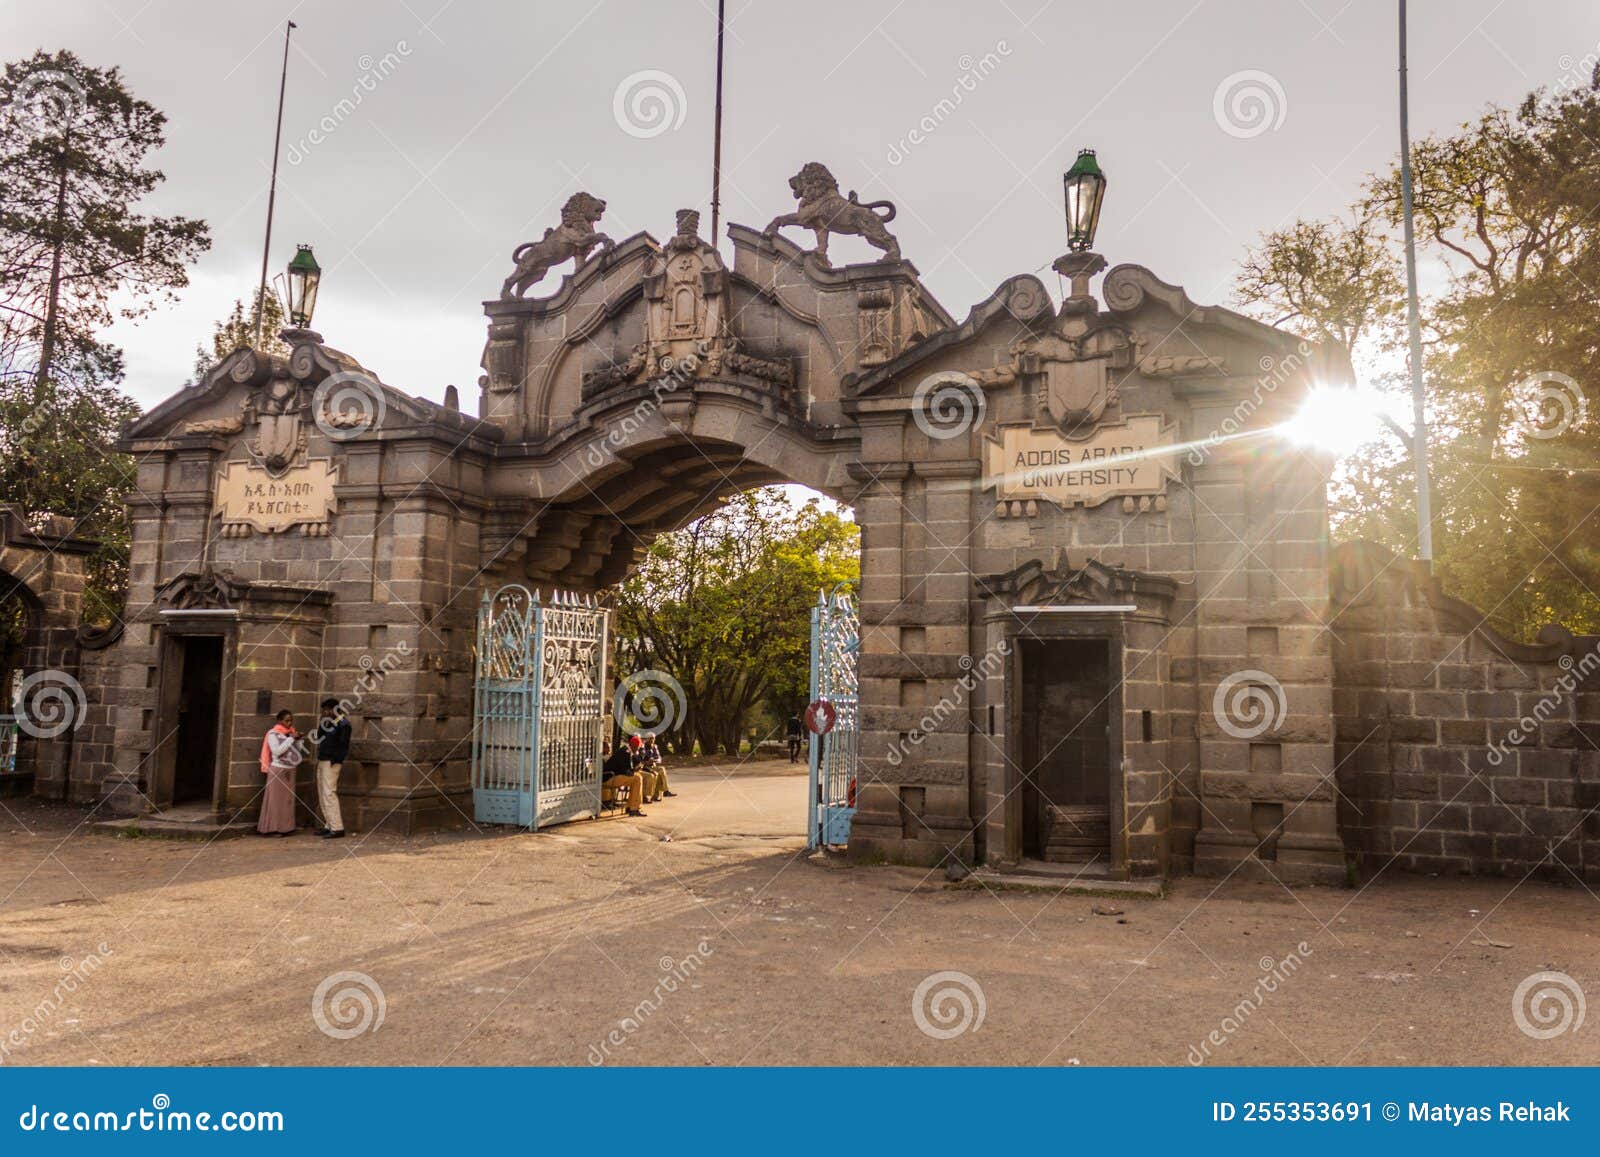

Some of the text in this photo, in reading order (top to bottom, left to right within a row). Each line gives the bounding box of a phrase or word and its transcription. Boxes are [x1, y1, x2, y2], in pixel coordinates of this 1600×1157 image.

[1015, 446, 1145, 468] ADDIS ABA
[1023, 467, 1139, 489] UNIVERSITY
